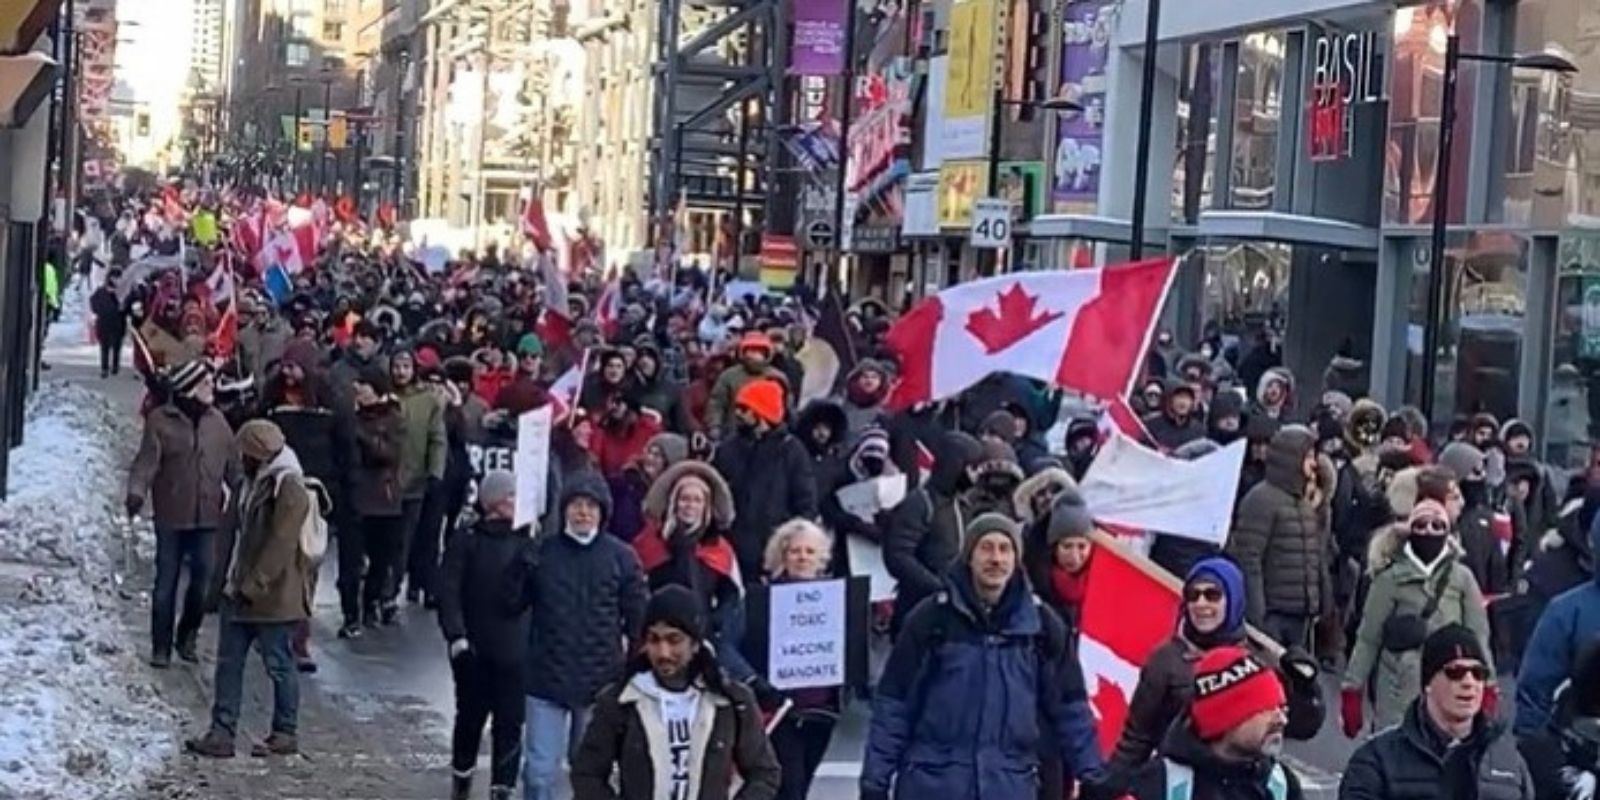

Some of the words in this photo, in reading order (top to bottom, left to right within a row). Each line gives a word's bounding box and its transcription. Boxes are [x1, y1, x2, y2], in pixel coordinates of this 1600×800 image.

[1314, 32, 1378, 105] BASIL
[976, 217, 1006, 240] 40
[465, 443, 519, 476] REE
[796, 590, 822, 603] END
[790, 612, 826, 626] TOXIC
[782, 641, 835, 656] VACCINE
[776, 663, 838, 679] MANDATE
[1196, 657, 1260, 695] TEAM
